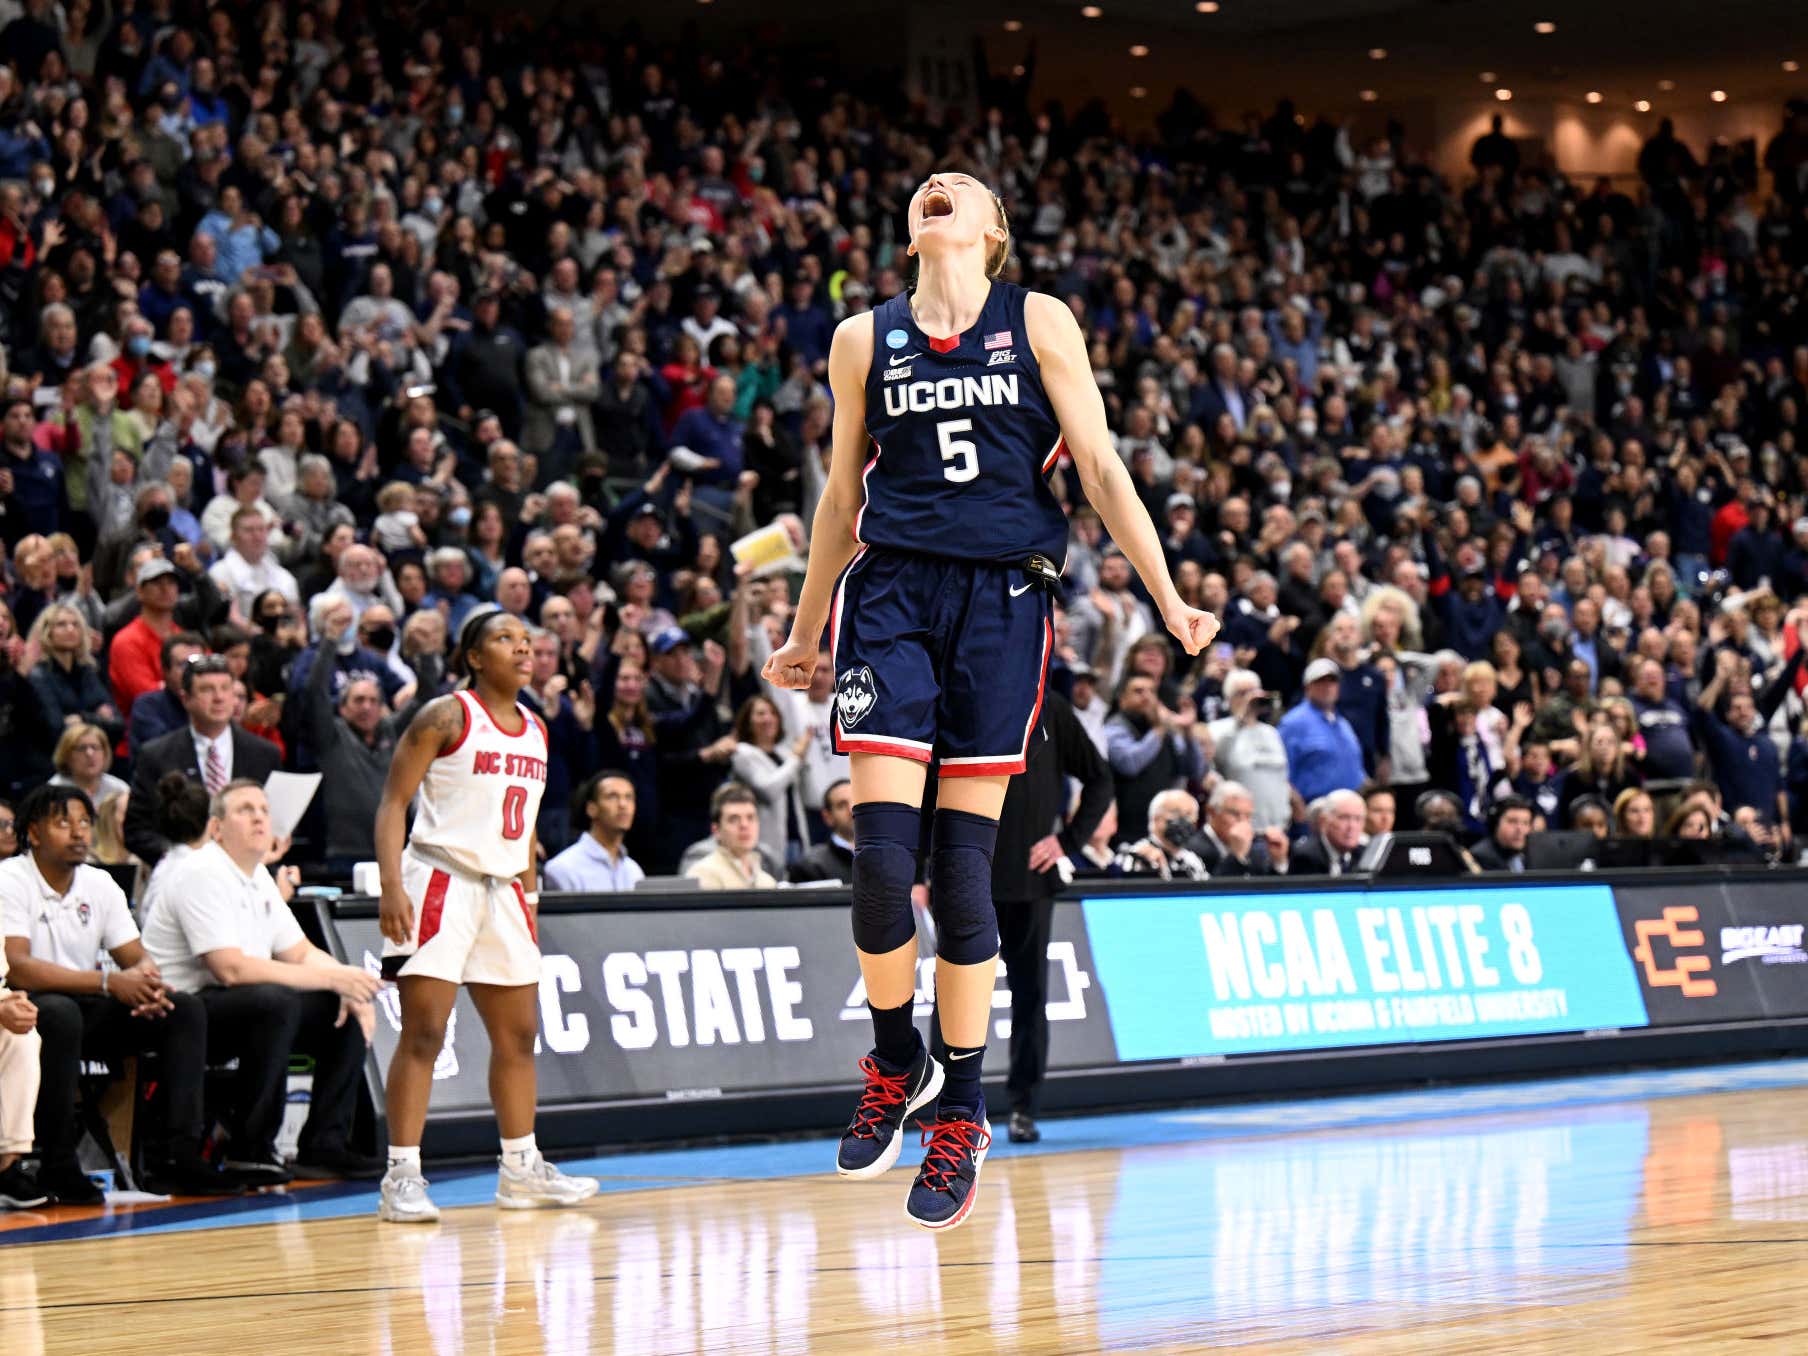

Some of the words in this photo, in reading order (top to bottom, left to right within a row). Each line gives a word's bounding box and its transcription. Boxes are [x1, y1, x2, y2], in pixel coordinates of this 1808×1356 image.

[883, 374, 1019, 417] UCONN
[936, 418, 980, 482] 5
[473, 750, 501, 775] NC
[502, 785, 528, 840] 0
[1201, 908, 1358, 1001] NCAA
[1356, 904, 1501, 993] ELITE
[1499, 903, 1543, 985] 8
[534, 954, 591, 1055] C
[602, 946, 815, 1050] STATE
[1208, 1005, 1284, 1040] HOSTED
[1284, 1003, 1311, 1035] BY
[1311, 1000, 1376, 1032] UCONN
[1474, 989, 1568, 1023] UNIVERSITY
